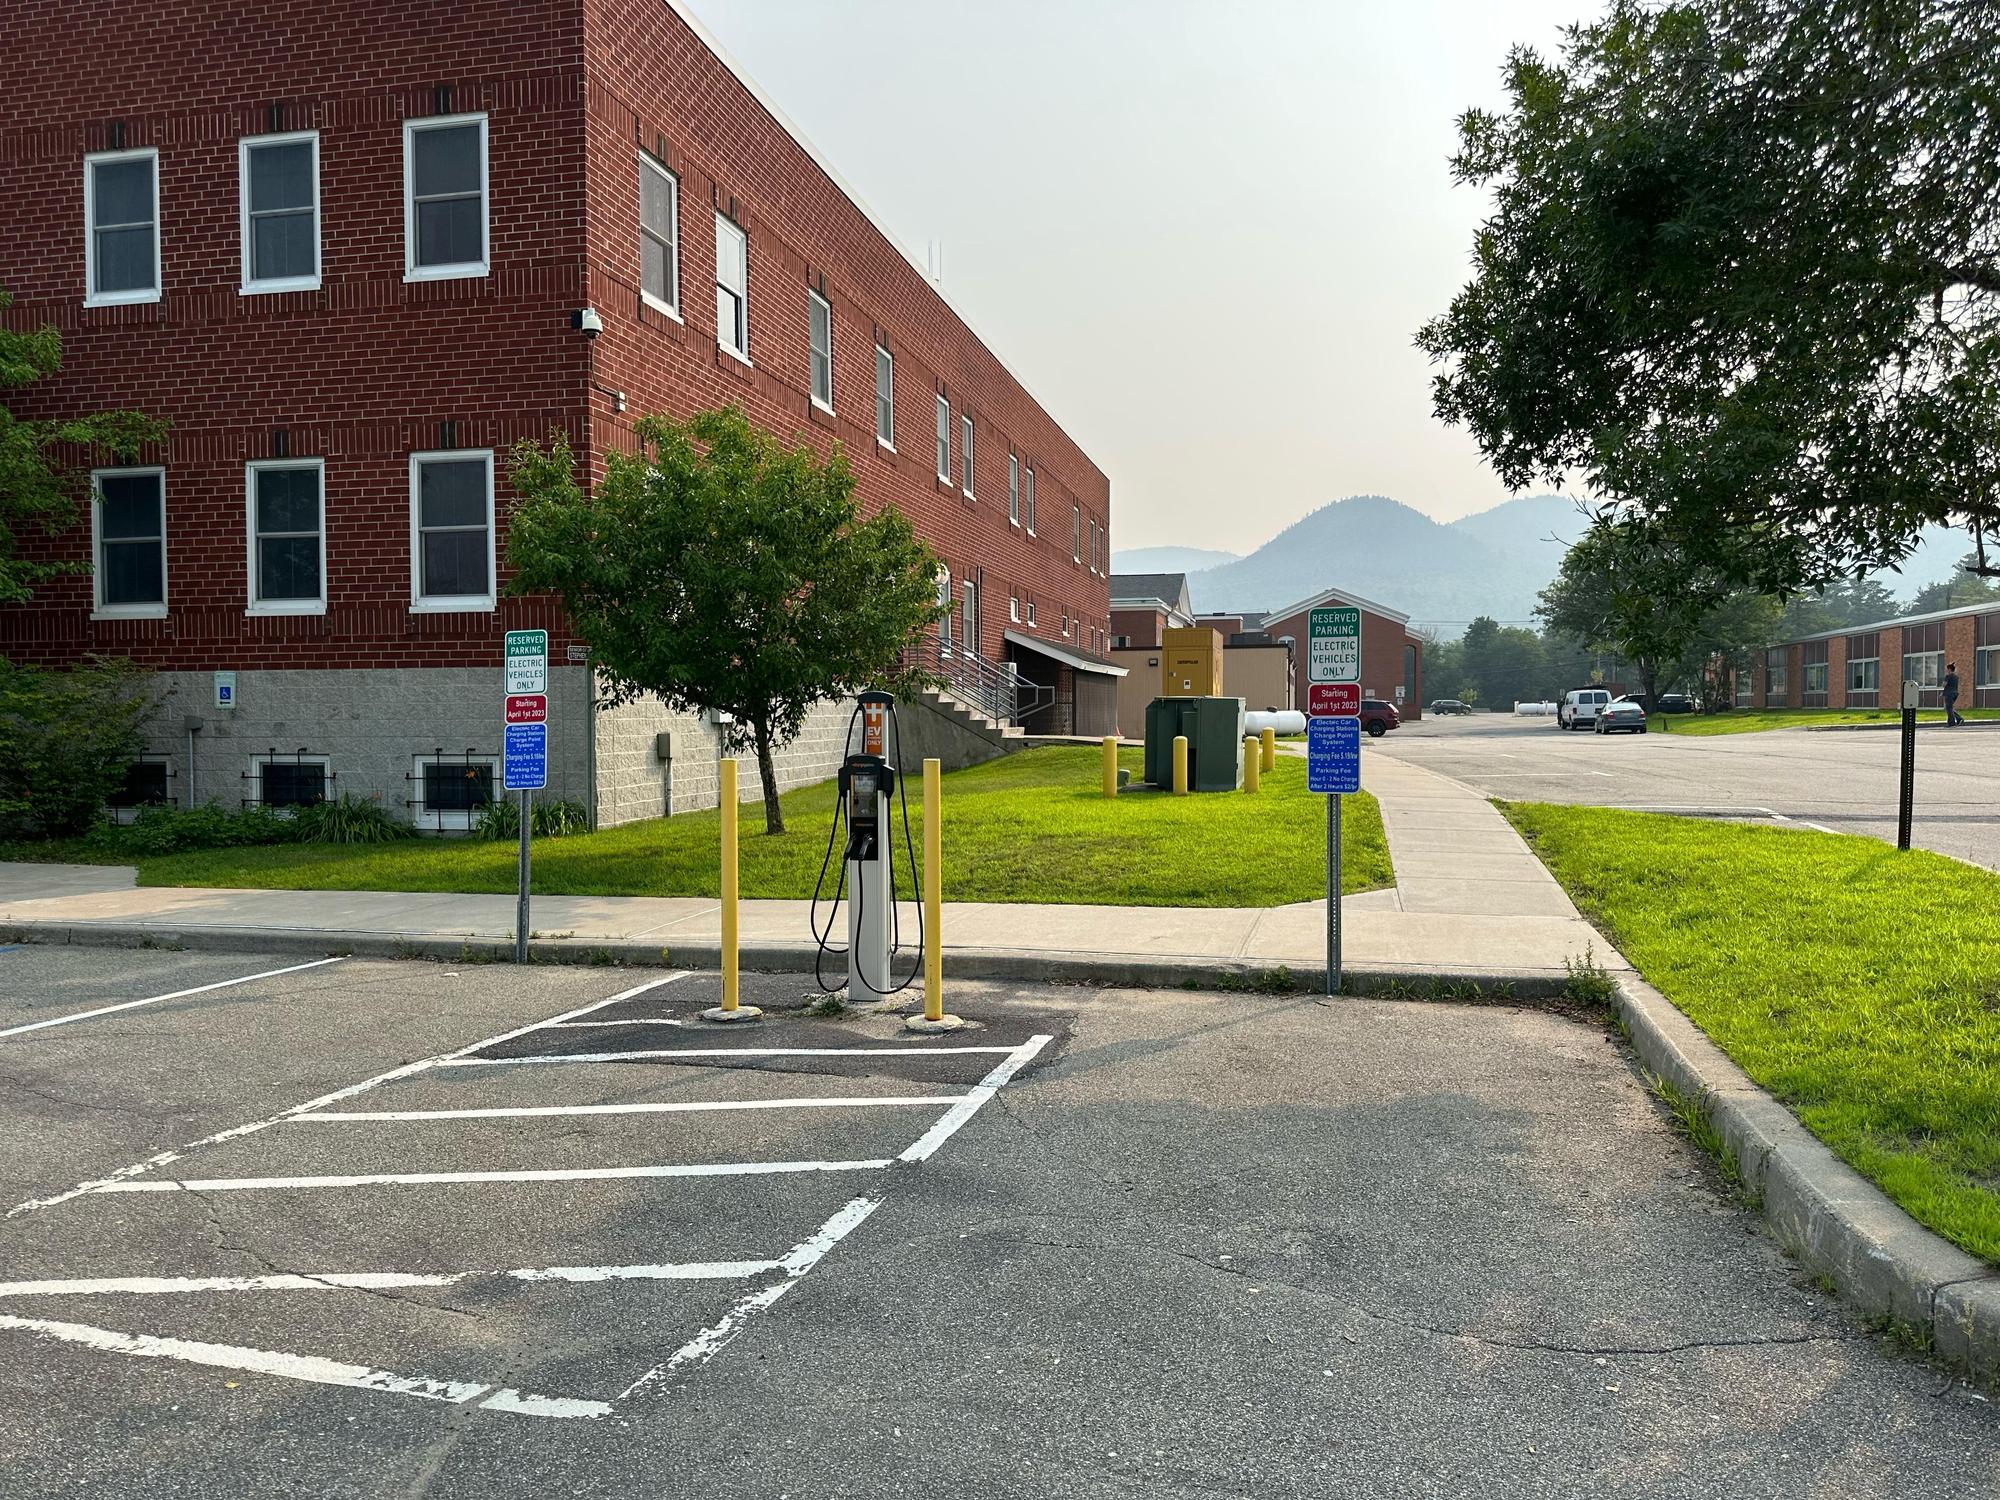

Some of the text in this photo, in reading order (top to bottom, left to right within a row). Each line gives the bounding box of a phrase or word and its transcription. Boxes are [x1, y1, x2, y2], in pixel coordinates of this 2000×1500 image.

[1312, 613, 1357, 623] RESERVED
[1316, 626, 1354, 635] PARKING
[508, 635, 544, 645] RESERVED
[1314, 641, 1355, 650] ELECTRIC
[510, 646, 542, 655] PARKING
[1313, 654, 1356, 663] VEHICLES
[509, 659, 542, 668] ELECTRIC
[509, 670, 543, 678] VEHICLES
[1323, 667, 1345, 676] ONLY
[517, 681, 534, 689] ONLY
[1321, 690, 1348, 698] Starting
[516, 700, 537, 708] Starting
[1312, 702, 1328, 711] April
[868, 727, 881, 736] EV
[1310, 752, 1330, 761] Charging
